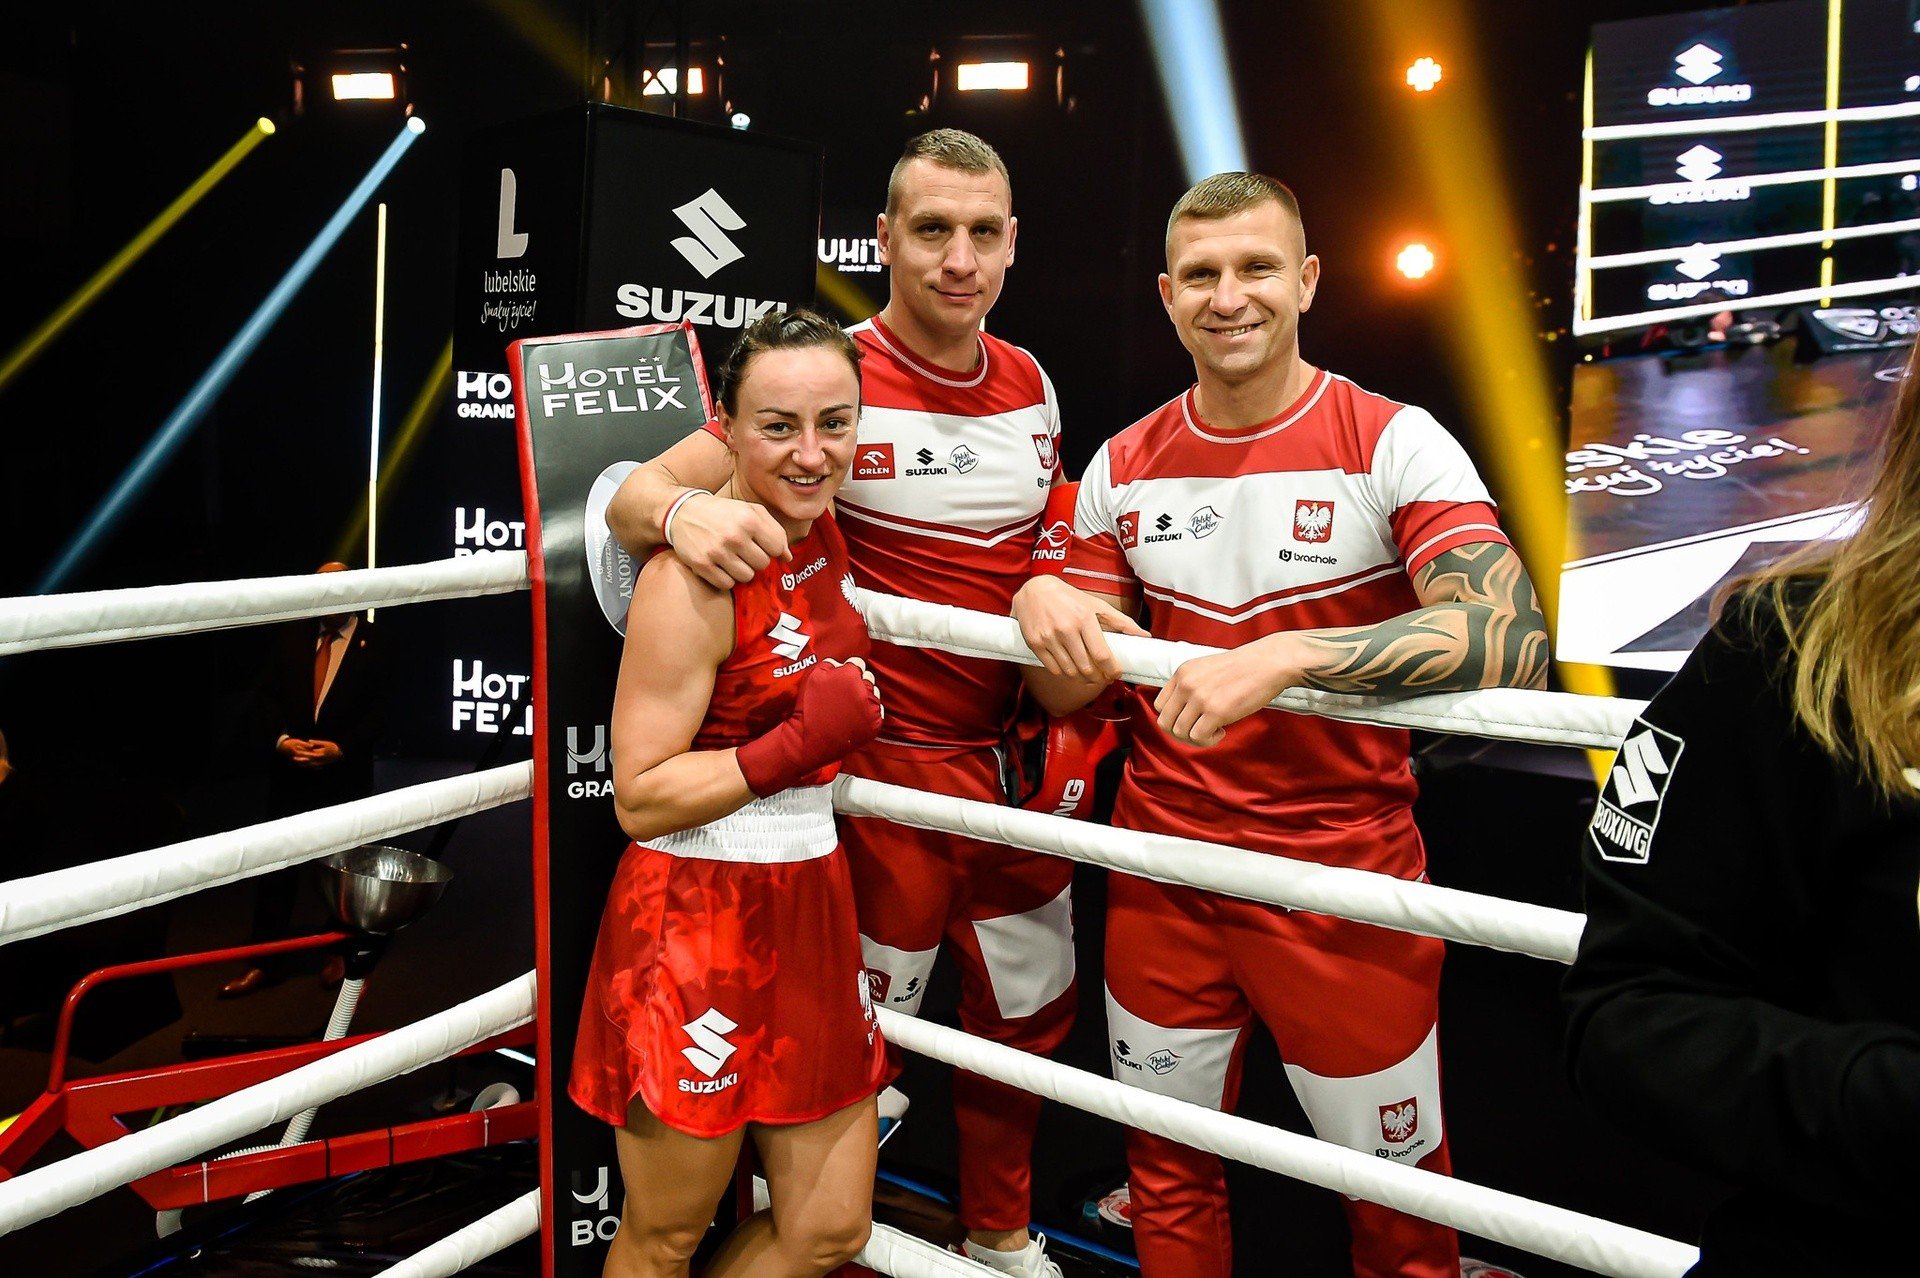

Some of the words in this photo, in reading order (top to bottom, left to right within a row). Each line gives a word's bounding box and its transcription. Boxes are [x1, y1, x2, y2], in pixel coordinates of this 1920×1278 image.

[484, 269, 536, 293] lubelskie
[542, 385, 688, 418] FELIX
[859, 467, 889, 475] ORLEN
[905, 467, 948, 477] SUZUKI
[1191, 514, 1213, 527] Polski
[1194, 521, 1218, 533] Cukier
[1144, 533, 1182, 543] SUZUKI
[1294, 552, 1338, 565] brachole
[796, 557, 827, 584] brachole
[773, 654, 817, 678] SUZUKI
[453, 659, 530, 700] HOT
[1594, 802, 1649, 858] BOXING
[678, 1072, 738, 1094] SUZUKI
